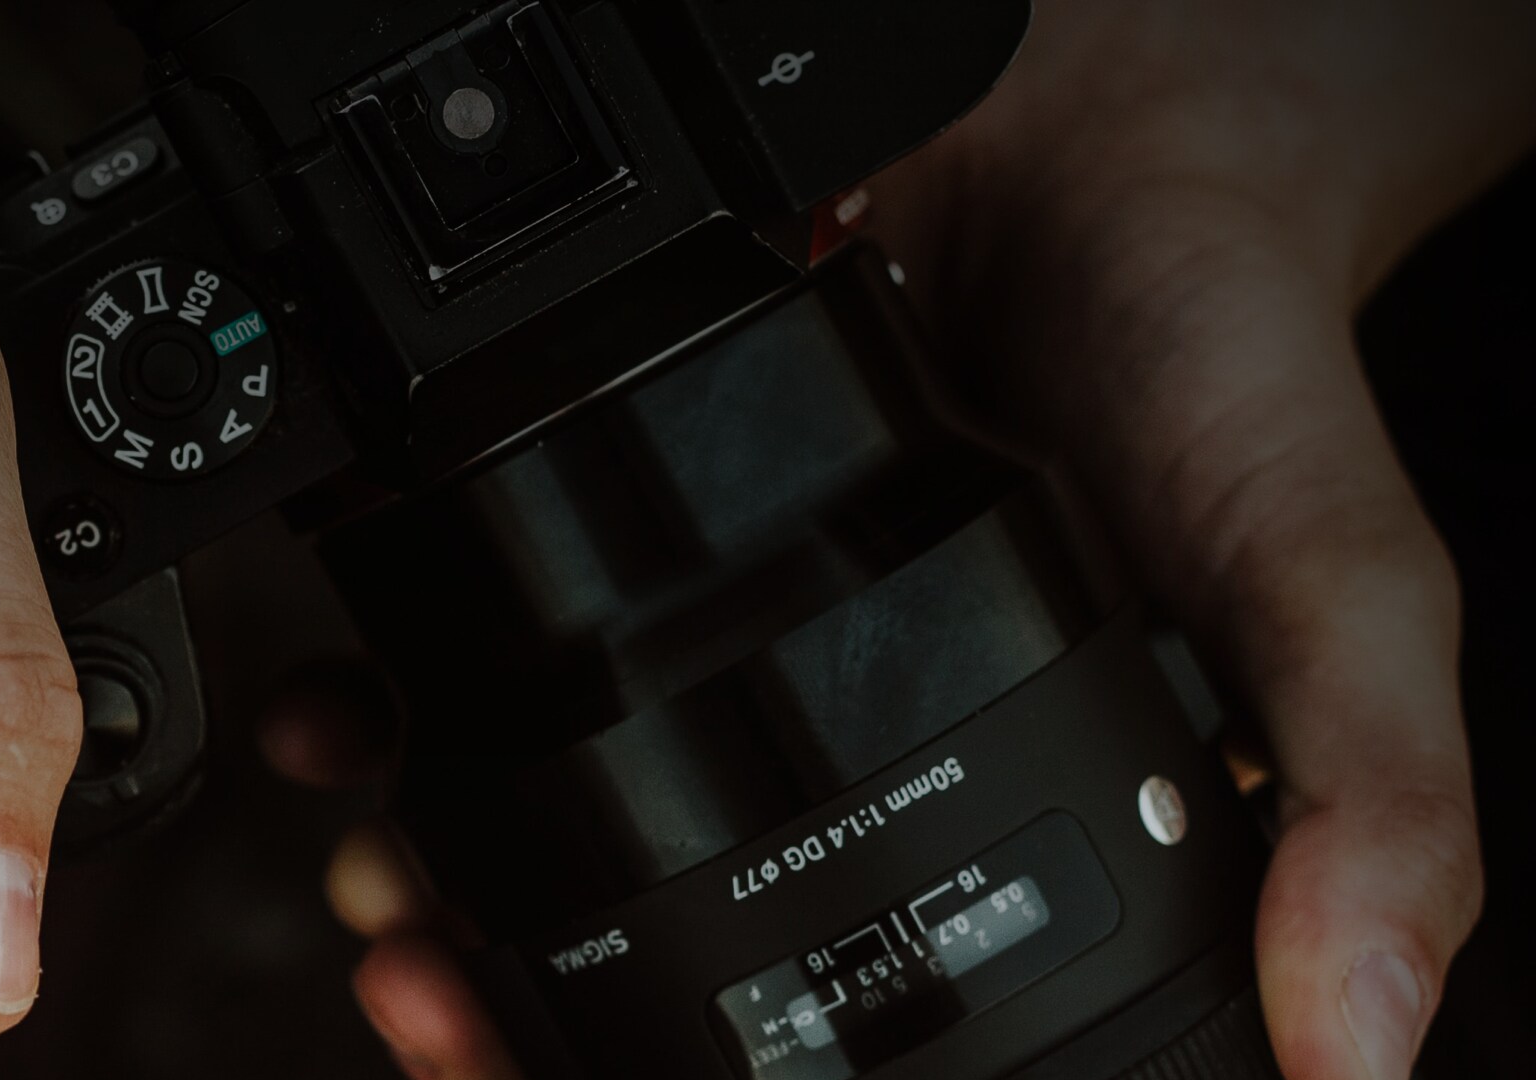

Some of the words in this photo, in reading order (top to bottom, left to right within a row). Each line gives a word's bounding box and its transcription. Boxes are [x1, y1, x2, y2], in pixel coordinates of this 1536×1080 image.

[90, 149, 139, 187] C3
[178, 269, 220, 326] SCN
[214, 312, 263, 352] AUTO
[71, 345, 96, 380] 2
[242, 364, 269, 397] P
[81, 399, 107, 428] 1
[219, 408, 254, 445] A
[114, 429, 155, 469] M
[170, 440, 205, 471] S
[54, 520, 101, 556] C2
[884, 757, 965, 812] 50mm
[827, 803, 886, 849] 1:1.4
[782, 835, 826, 871] DG
[957, 864, 987, 893] 16
[939, 914, 970, 946] 0.7
[547, 928, 629, 976] SIGMA
[806, 947, 836, 974] 16
